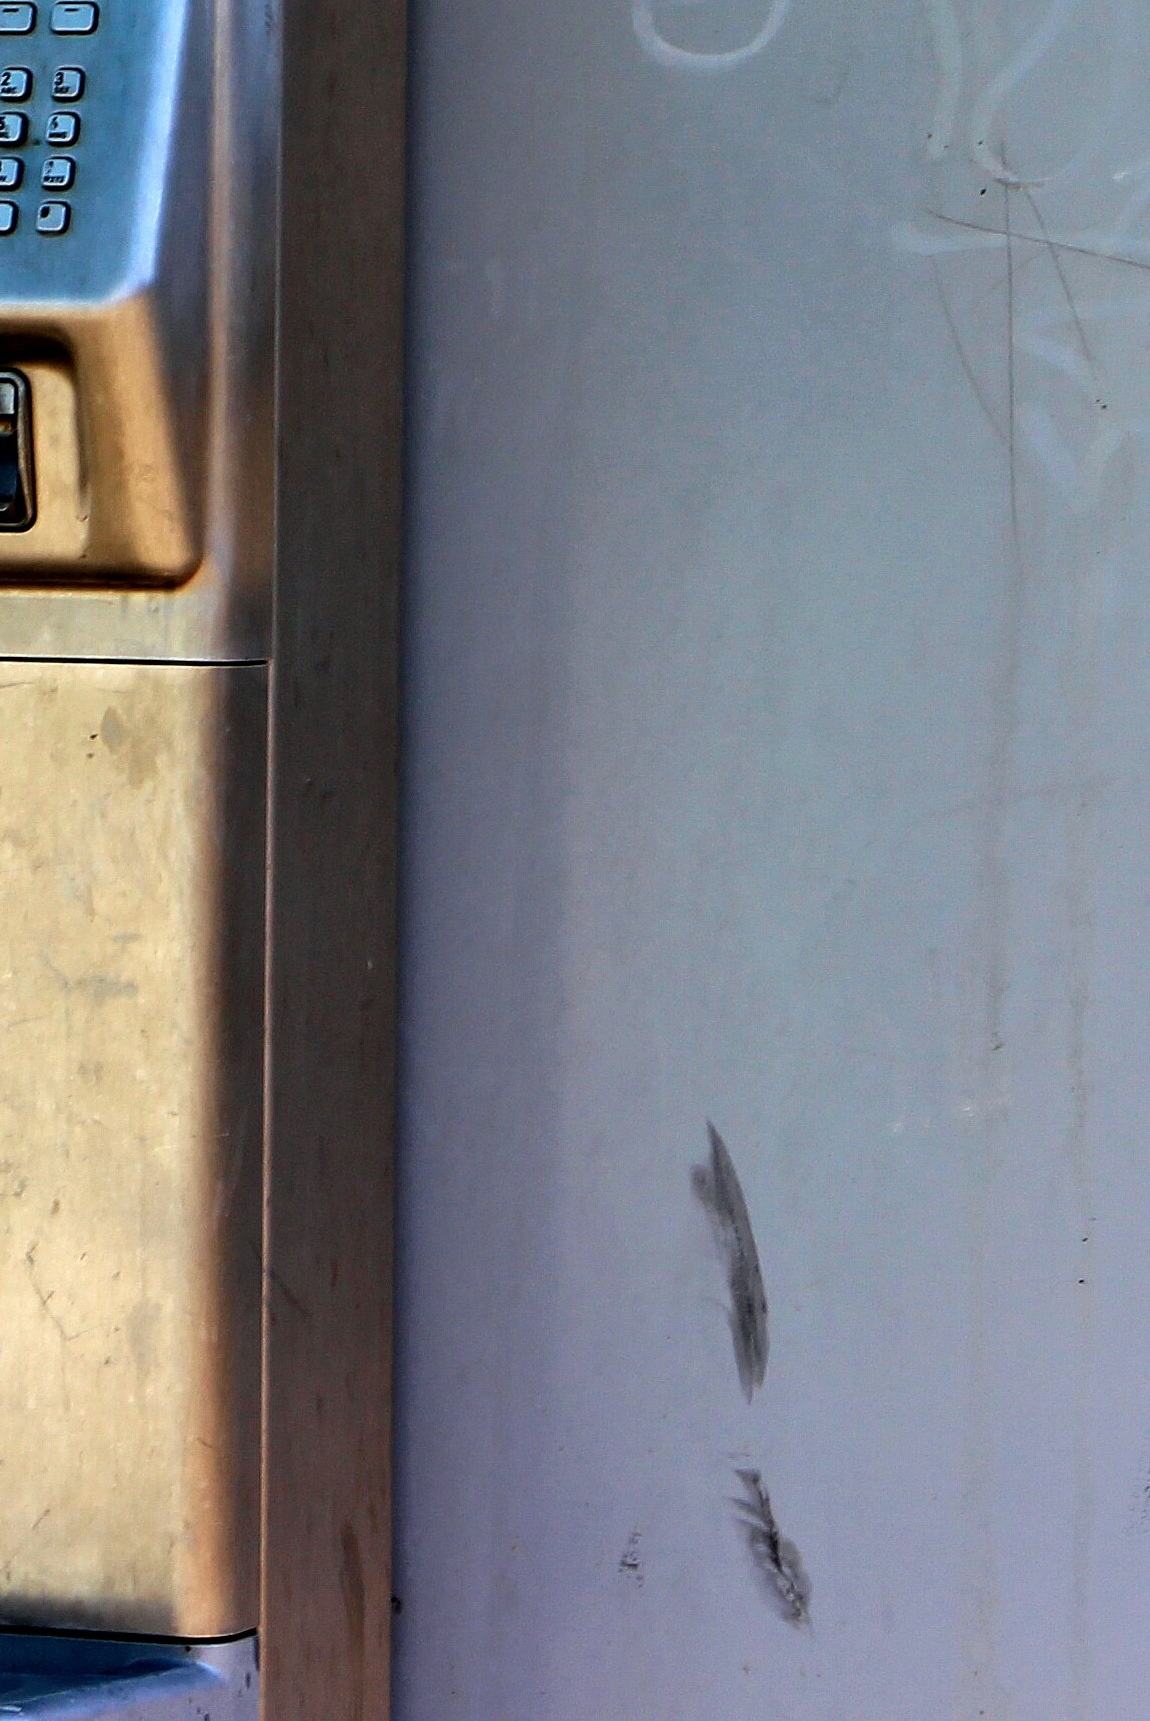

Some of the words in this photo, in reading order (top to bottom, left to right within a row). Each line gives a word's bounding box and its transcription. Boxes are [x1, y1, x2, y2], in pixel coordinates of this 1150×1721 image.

[1, 71, 11, 86] 2
[54, 71, 64, 86] 3
[50, 117, 58, 129] 6
